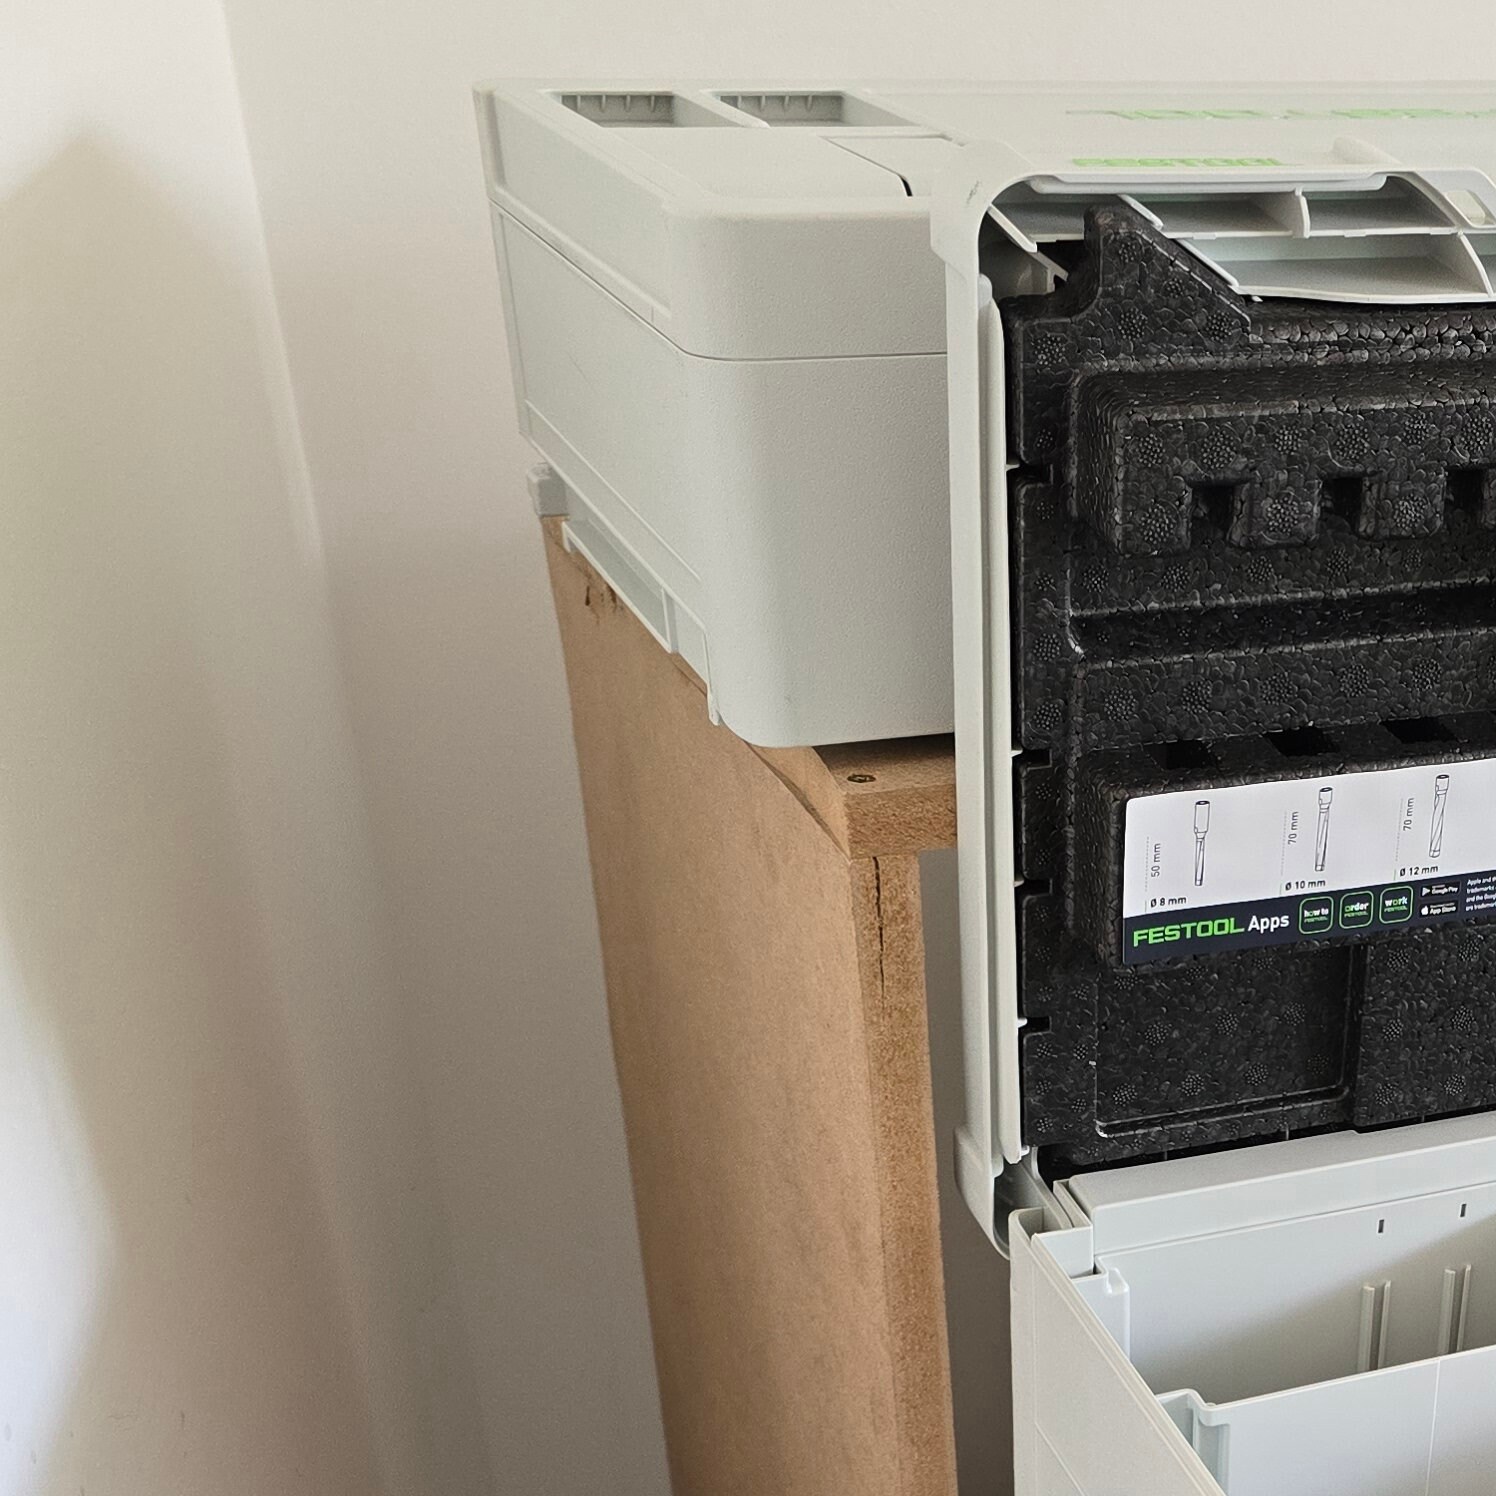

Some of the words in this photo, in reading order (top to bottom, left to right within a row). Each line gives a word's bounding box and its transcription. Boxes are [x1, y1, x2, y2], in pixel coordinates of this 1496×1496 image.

[1406, 798, 1414, 816] mm
[1291, 811, 1299, 830] mm
[1403, 819, 1412, 831] 70
[1288, 833, 1297, 845] 70
[1153, 843, 1161, 863] mm
[1151, 865, 1161, 877] 50
[1409, 866, 1419, 875] 12
[1421, 866, 1438, 874] mm
[1295, 880, 1305, 889] 10
[1308, 880, 1326, 888] mm
[1160, 896, 1165, 905] 8
[1168, 896, 1187, 905] mm
[1344, 901, 1369, 912] order
[1384, 896, 1408, 906] work
[1133, 917, 1245, 947] FESTOOL
[1248, 914, 1290, 934] Apps
